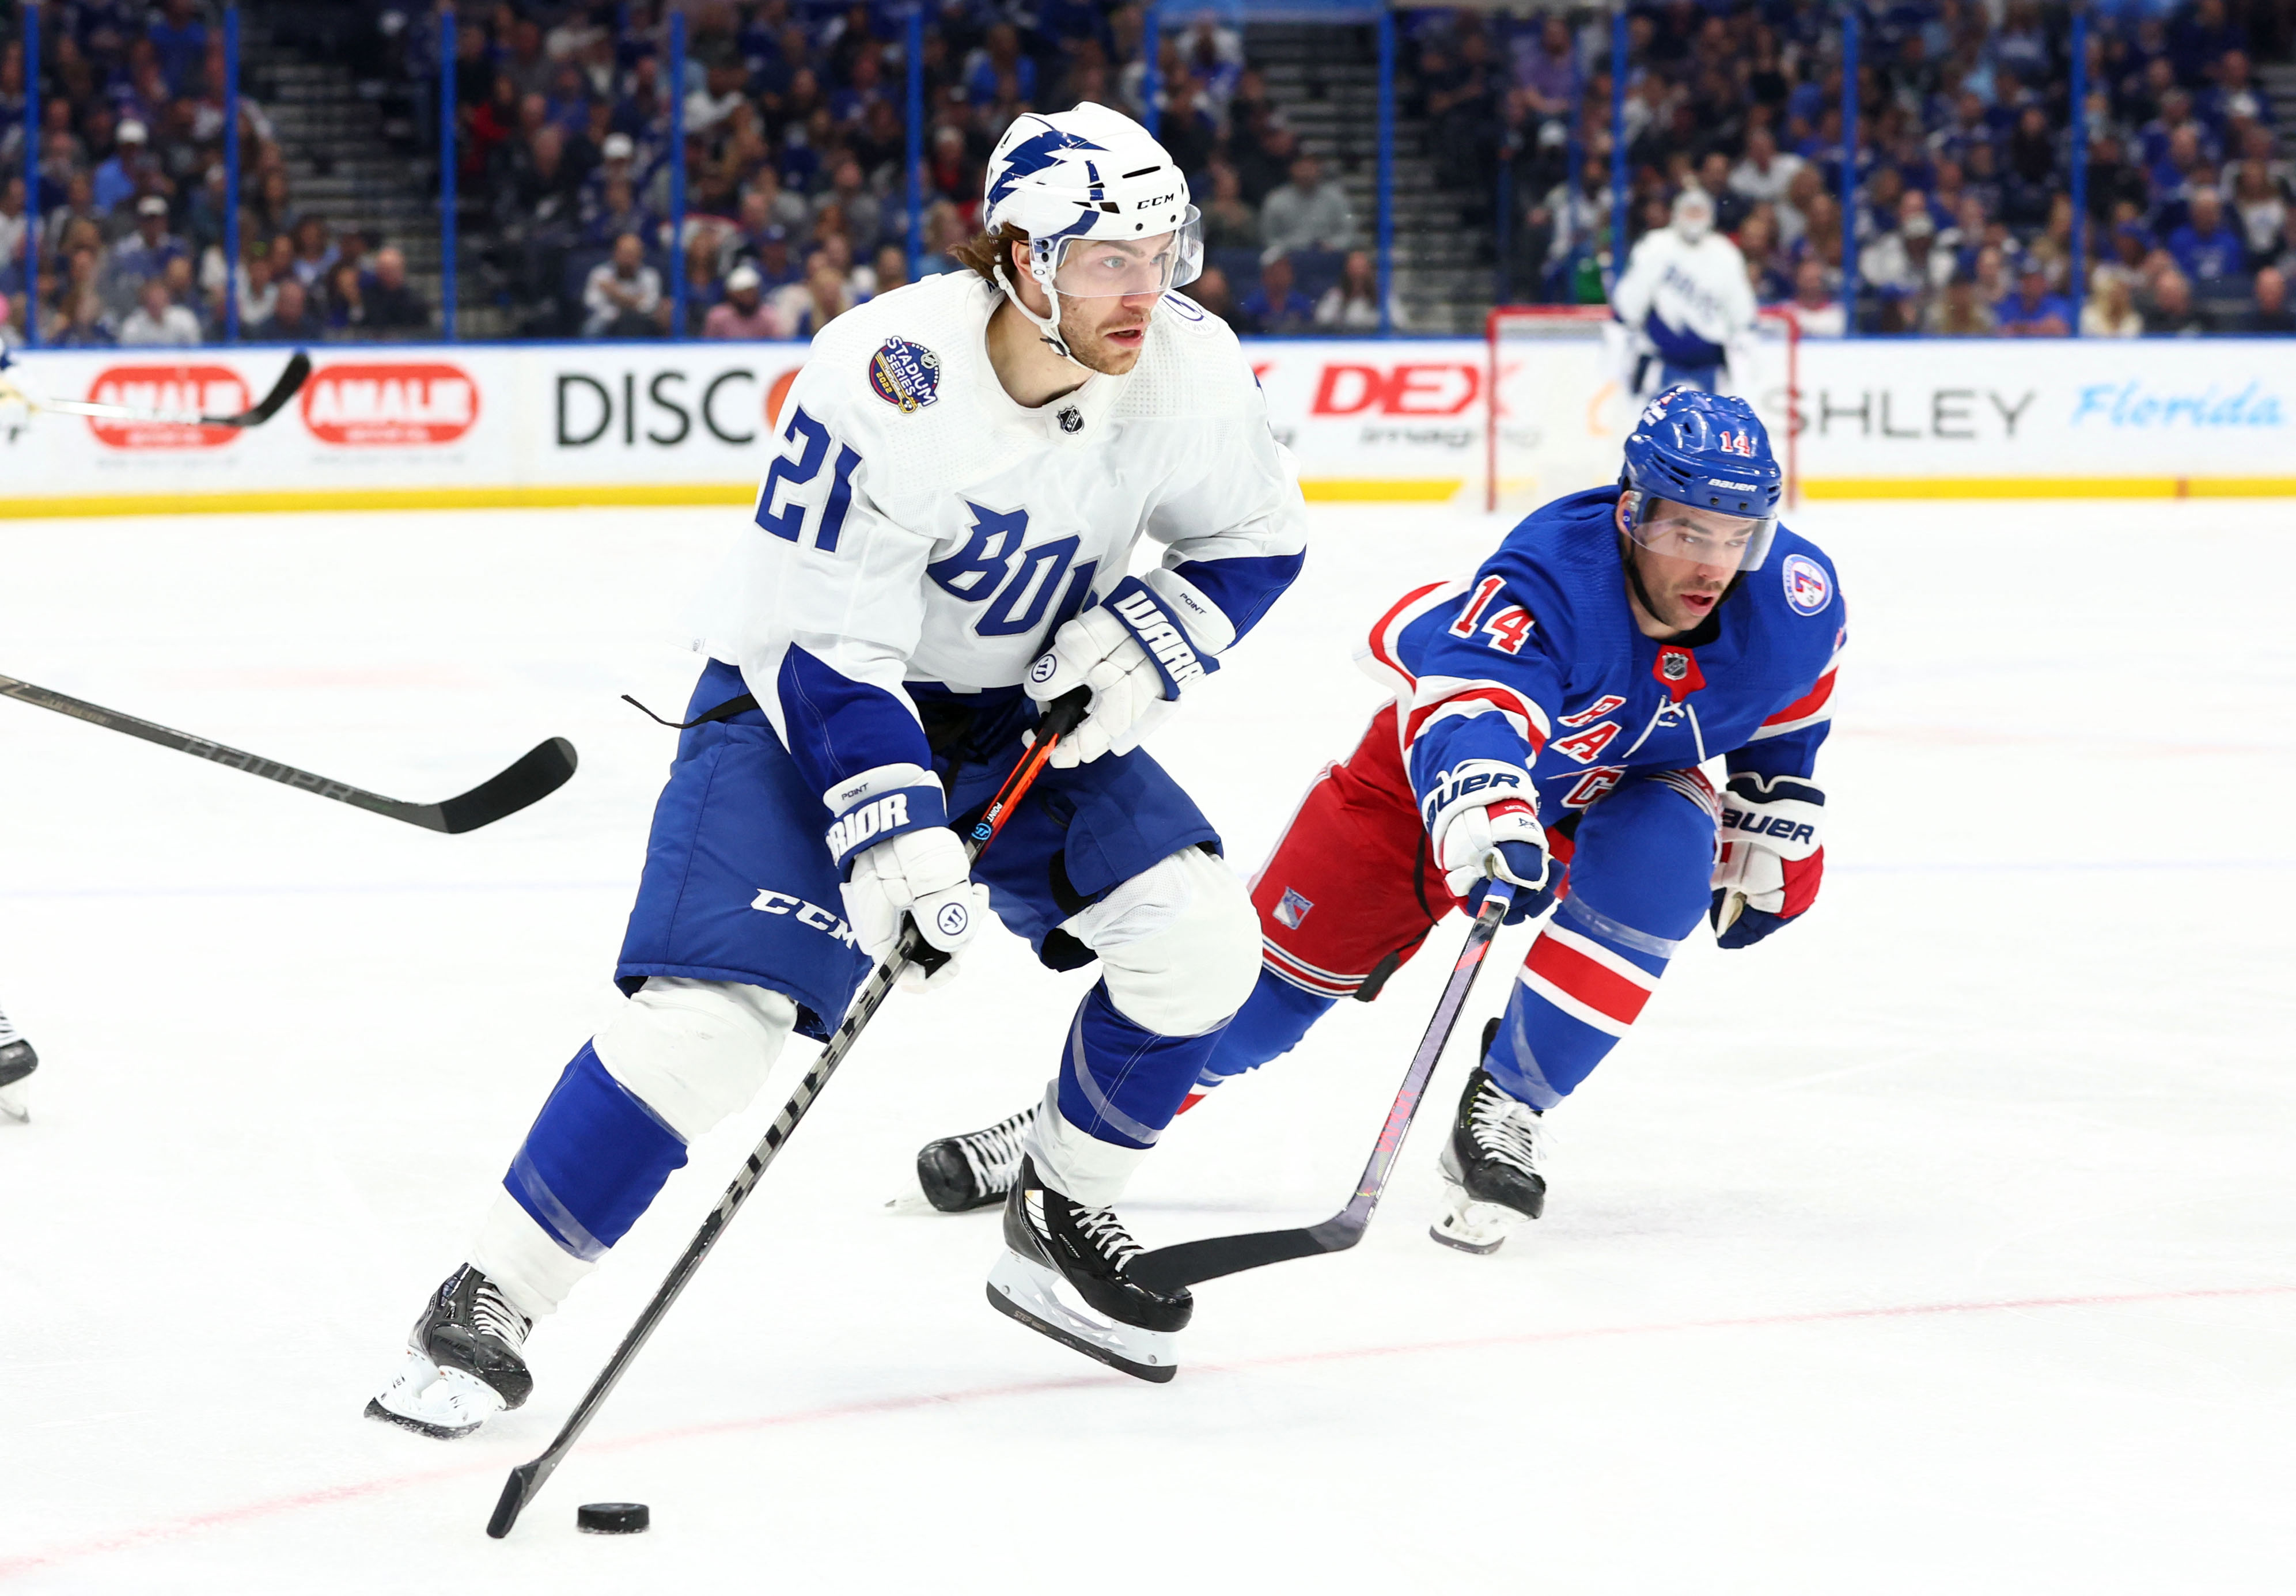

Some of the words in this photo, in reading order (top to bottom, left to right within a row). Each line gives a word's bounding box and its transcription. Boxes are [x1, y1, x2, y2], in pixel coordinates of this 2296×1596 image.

[1136, 193, 1174, 210] CCM
[876, 371, 893, 394] 2022
[885, 354, 916, 396] SERIES
[886, 336, 937, 406] STADIUM
[2070, 379, 2284, 427] Florida
[1719, 431, 1753, 459] 14
[752, 400, 865, 555] 21
[1179, 593, 1207, 615] POINT
[1447, 574, 1537, 655] 14
[841, 782, 869, 801] POINT
[987, 802, 1003, 824] POINT
[750, 888, 861, 950] CCM
[1013, 1310, 1032, 1322] STEP
